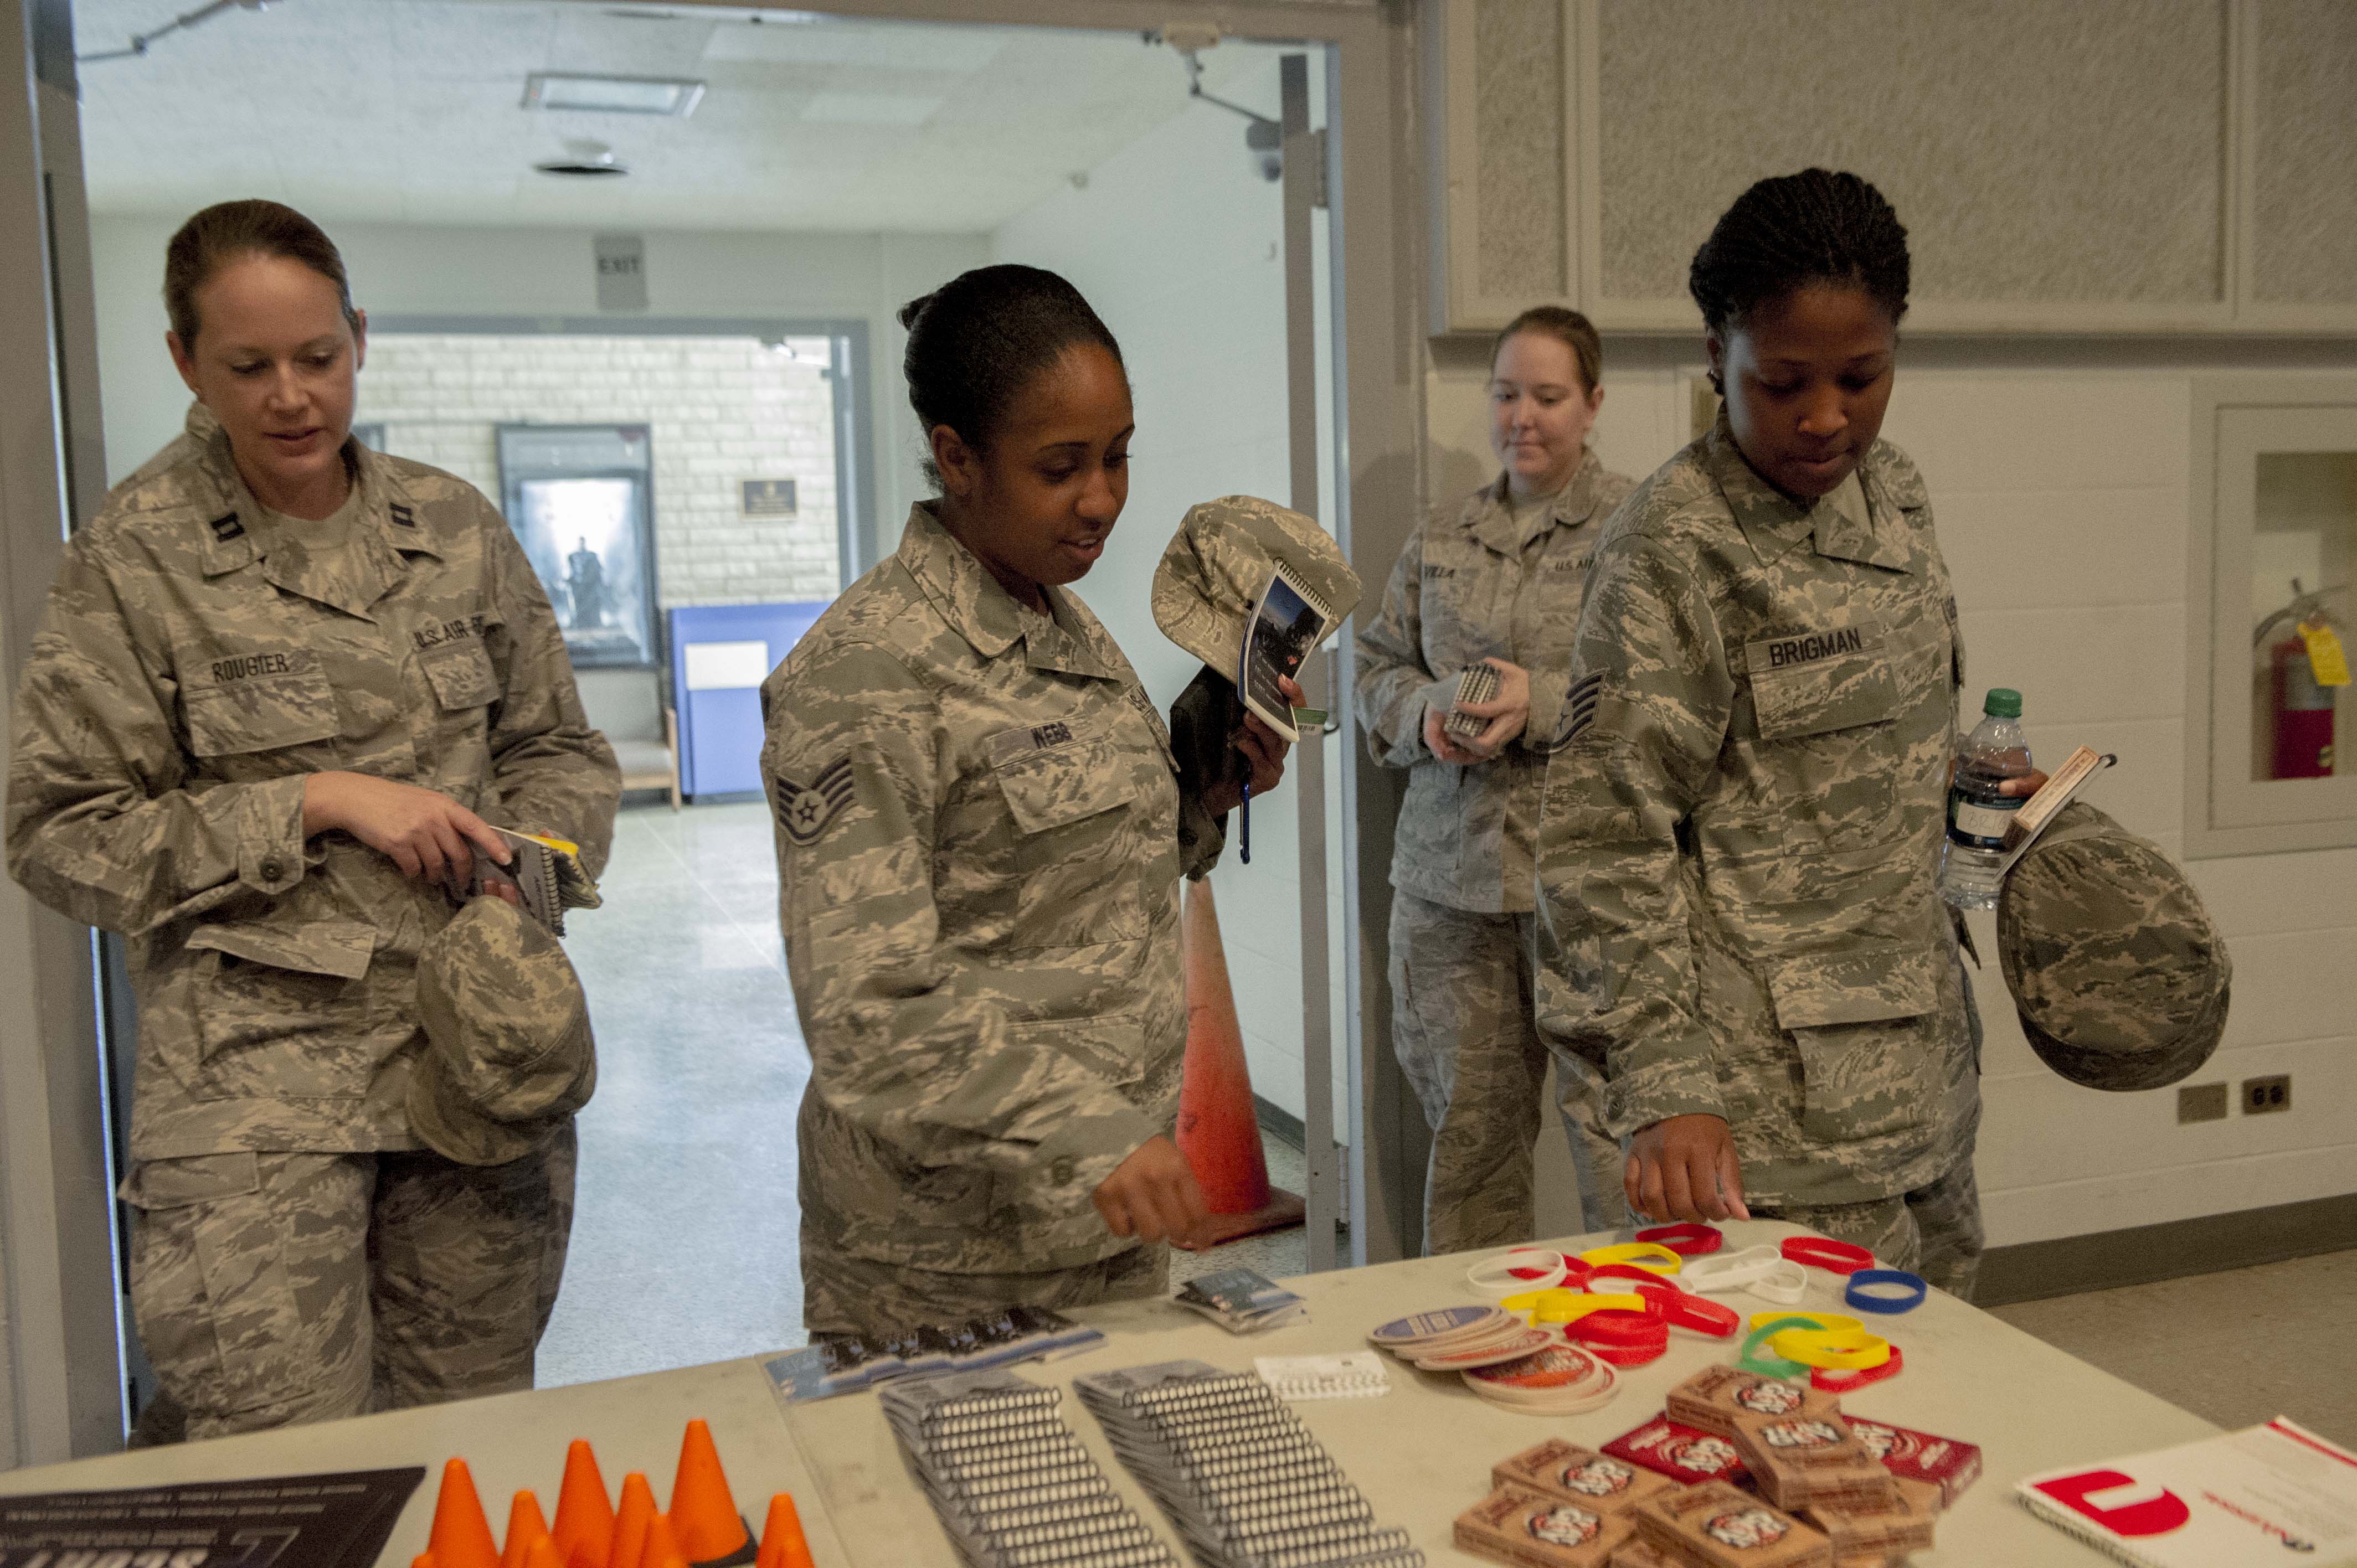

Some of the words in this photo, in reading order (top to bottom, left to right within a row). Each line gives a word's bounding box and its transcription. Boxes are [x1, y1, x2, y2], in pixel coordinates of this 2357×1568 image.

[443, 619, 470, 641] AIR
[1769, 627, 1862, 667] BRIGMAN
[212, 653, 289, 683] ROUGIER
